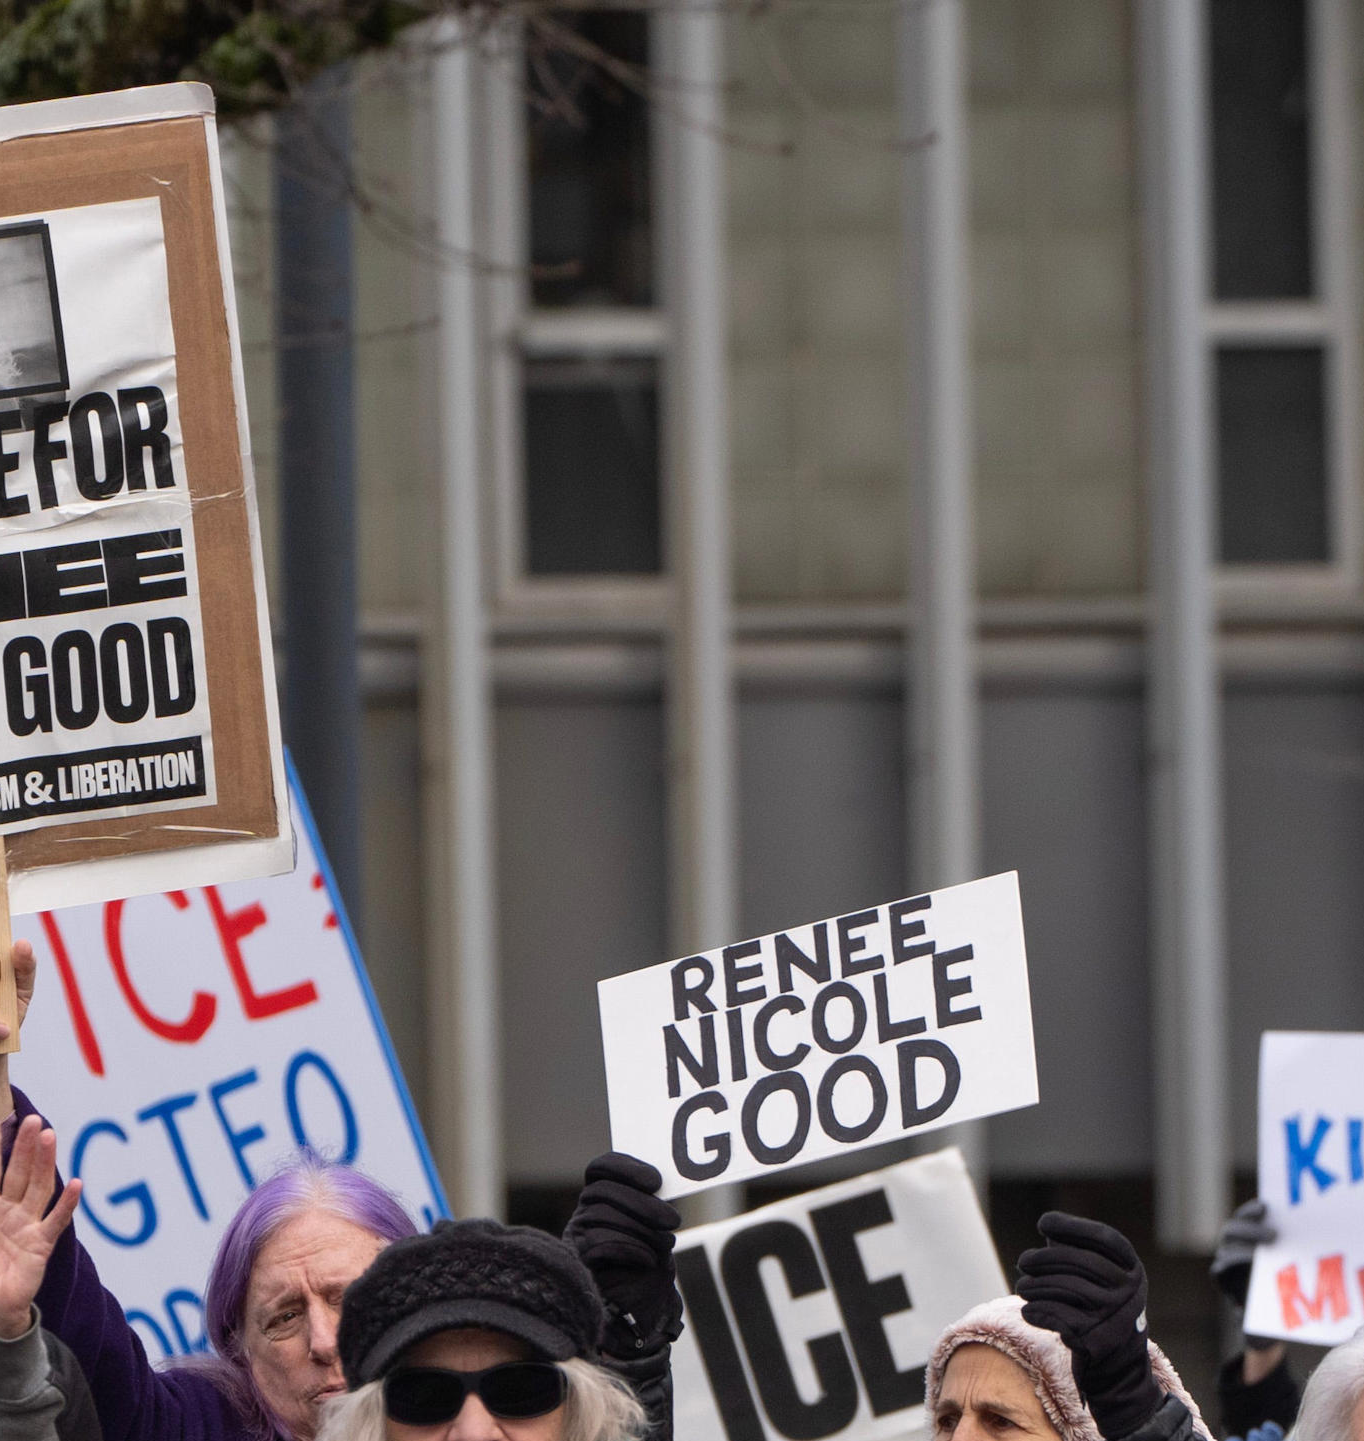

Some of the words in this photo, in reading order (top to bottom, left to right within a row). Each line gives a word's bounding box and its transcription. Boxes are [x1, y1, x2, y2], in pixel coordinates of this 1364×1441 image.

[32, 385, 176, 509] FOR
[2, 616, 196, 735] GOOD
[24, 771, 55, 806] &
[57, 750, 196, 800] LIBERATION
[661, 943, 983, 1098] NICOLE
[670, 895, 936, 1021] RENEE
[69, 1049, 360, 1249] GTFO
[671, 1039, 961, 1182] GOOD
